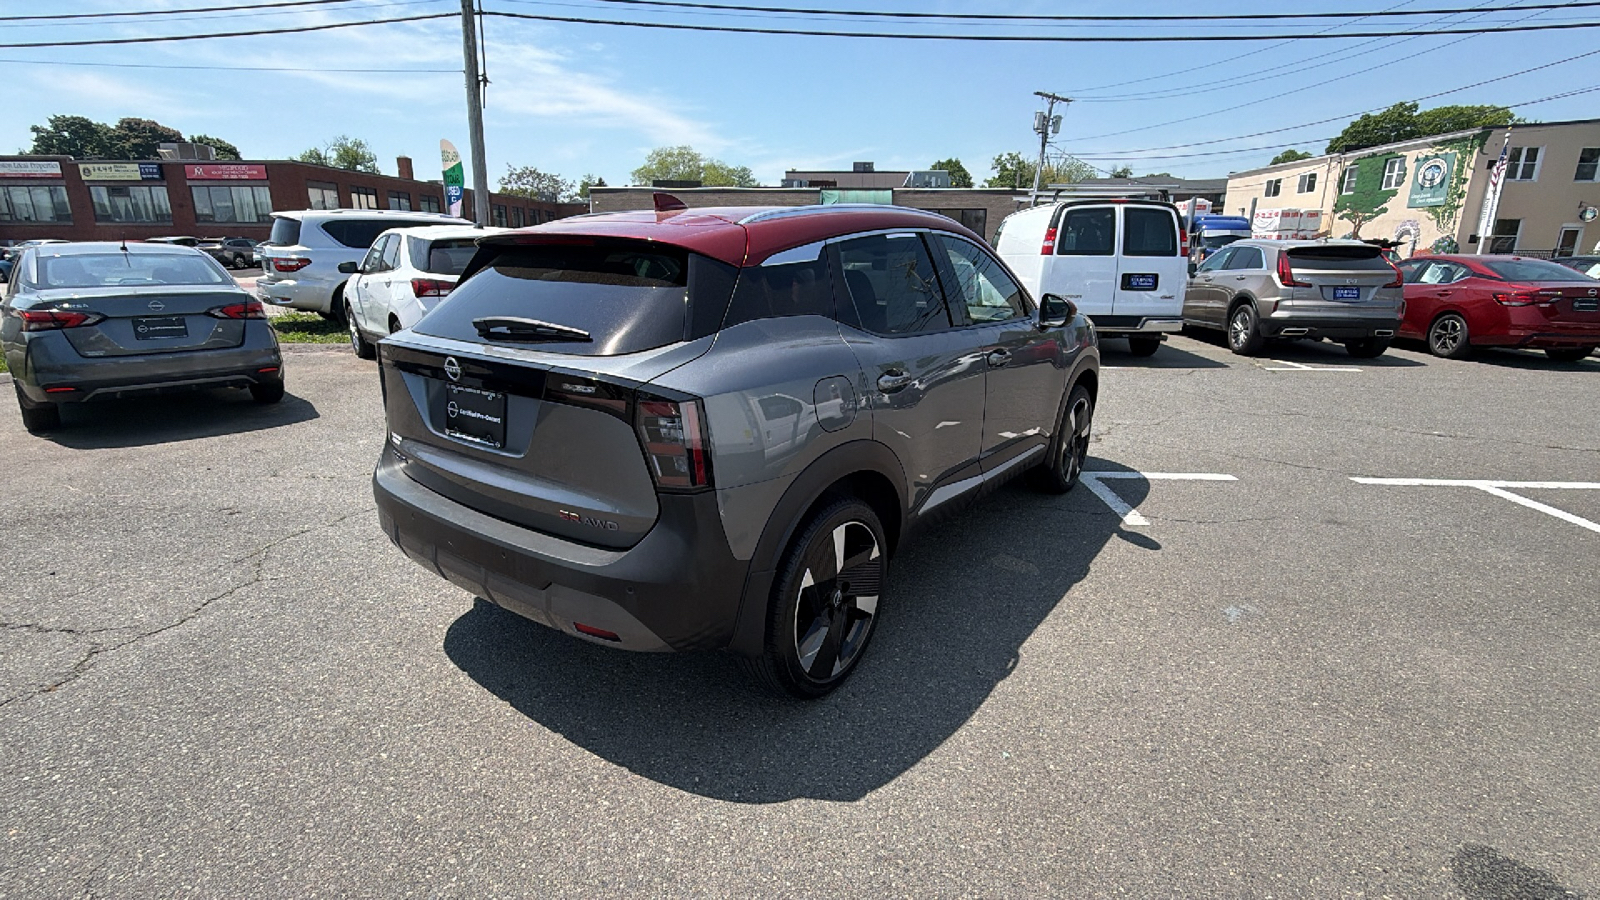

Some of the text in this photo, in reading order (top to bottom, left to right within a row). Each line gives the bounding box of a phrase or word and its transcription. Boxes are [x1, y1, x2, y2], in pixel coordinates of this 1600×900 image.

[30, 162, 59, 170] Properties
[448, 186, 460, 195] USED
[459, 408, 501, 424] Certified Pre-Owned
[559, 509, 620, 531] SR AWD
